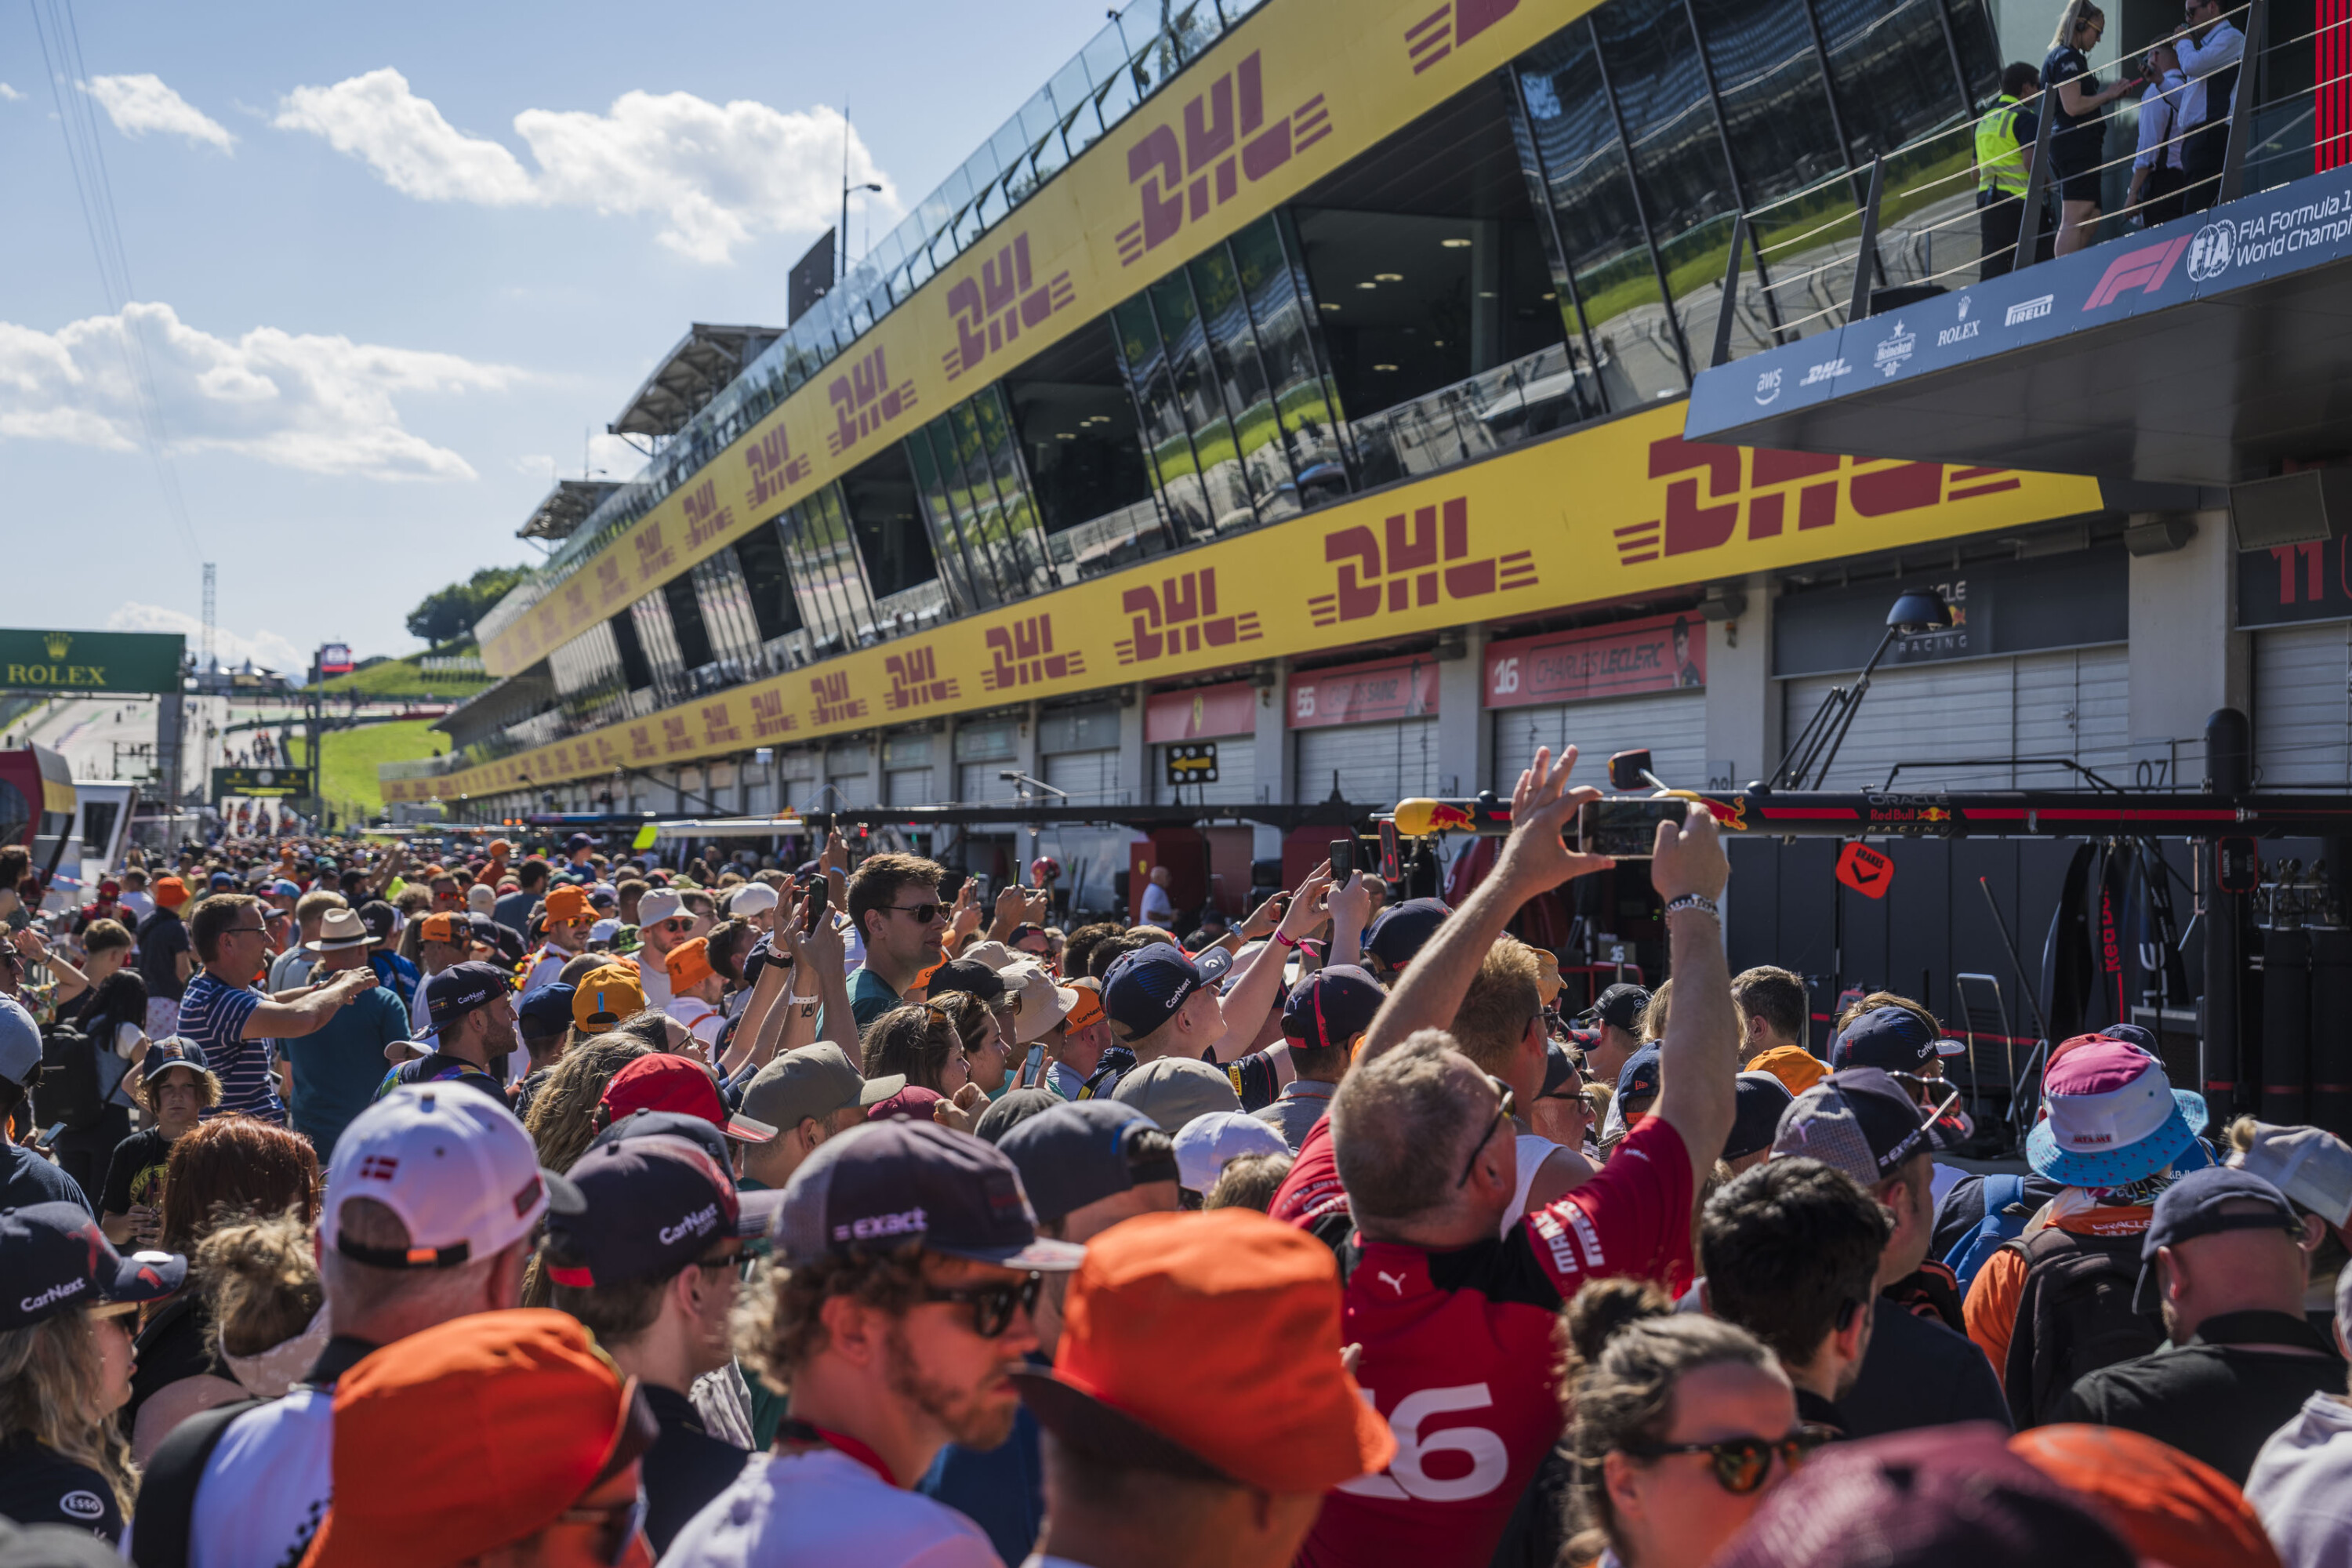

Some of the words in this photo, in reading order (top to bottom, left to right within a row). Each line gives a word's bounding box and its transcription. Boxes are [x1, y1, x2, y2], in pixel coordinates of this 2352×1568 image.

[1127, 49, 1291, 252] DHL
[2239, 216, 2265, 242] FIA
[2269, 196, 2339, 234] Formula
[2342, 190, 2351, 212] 1
[2237, 234, 2285, 267] World
[947, 231, 1051, 371] DHL
[2005, 294, 2054, 326] PIRELLI
[1937, 320, 1980, 347] ROLEX
[1757, 368, 1782, 392] aws
[1808, 358, 1846, 384] DHL
[829, 345, 902, 455] DHL
[746, 423, 800, 506] DHL
[1325, 496, 1496, 621] DHL
[2270, 540, 2323, 604] 11
[1122, 567, 1236, 662] DHL
[986, 613, 1068, 690] DHL
[1899, 635, 1967, 652] RACING
[7, 664, 107, 686] ROLEX
[886, 645, 948, 709] DHL
[1494, 658, 1519, 695] 16
[1536, 652, 1599, 684] CHARLES
[1599, 642, 1664, 674] LECLERC
[811, 671, 858, 724] DHL
[1297, 686, 1315, 718] 55
[2136, 759, 2167, 791] 07
[1868, 794, 1950, 806] ORACLE
[1610, 946, 1624, 963] 16
[458, 989, 486, 1004] CarNext
[1166, 978, 1191, 1010] CarNext
[1077, 1007, 1101, 1024] CarNext
[659, 1203, 717, 1245] CarNext
[853, 1207, 928, 1239] exact
[2092, 1219, 2152, 1231] ORACLE
[20, 1277, 86, 1312] CarNext
[1336, 1382, 1508, 1502] 6
[68, 1497, 99, 1512] Esso
